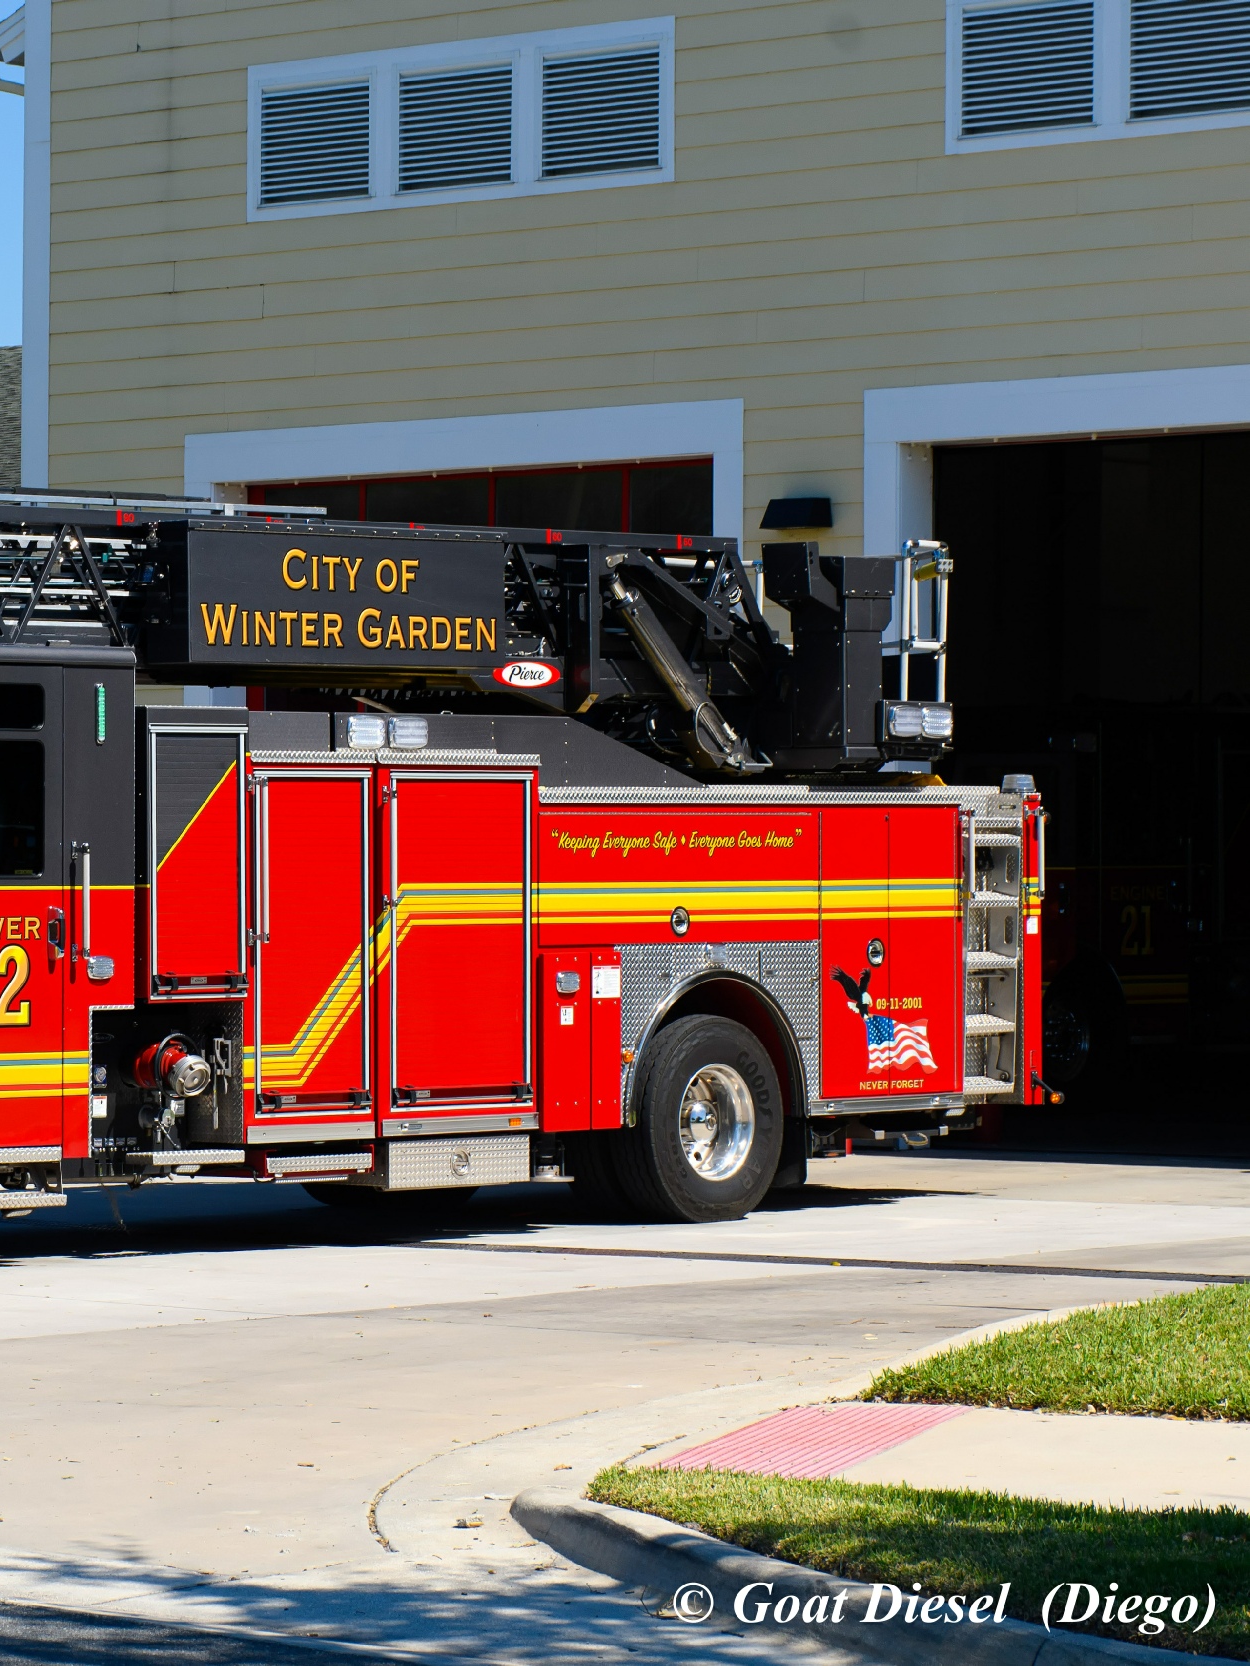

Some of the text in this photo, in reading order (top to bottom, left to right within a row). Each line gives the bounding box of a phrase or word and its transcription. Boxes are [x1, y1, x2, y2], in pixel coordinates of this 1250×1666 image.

[282, 548, 420, 594] CITY OF
[200, 603, 497, 653] WINTER GARDEN
[508, 665, 545, 682] Pierce
[602, 831, 650, 858] Everyone
[652, 830, 677, 856] Safe
[688, 831, 735, 857] Everyone
[738, 830, 762, 848] Goes
[1119, 904, 1155, 957] 21
[875, 997, 923, 1010] 09-11-2001
[859, 1079, 924, 1091] NEVER FORGET
